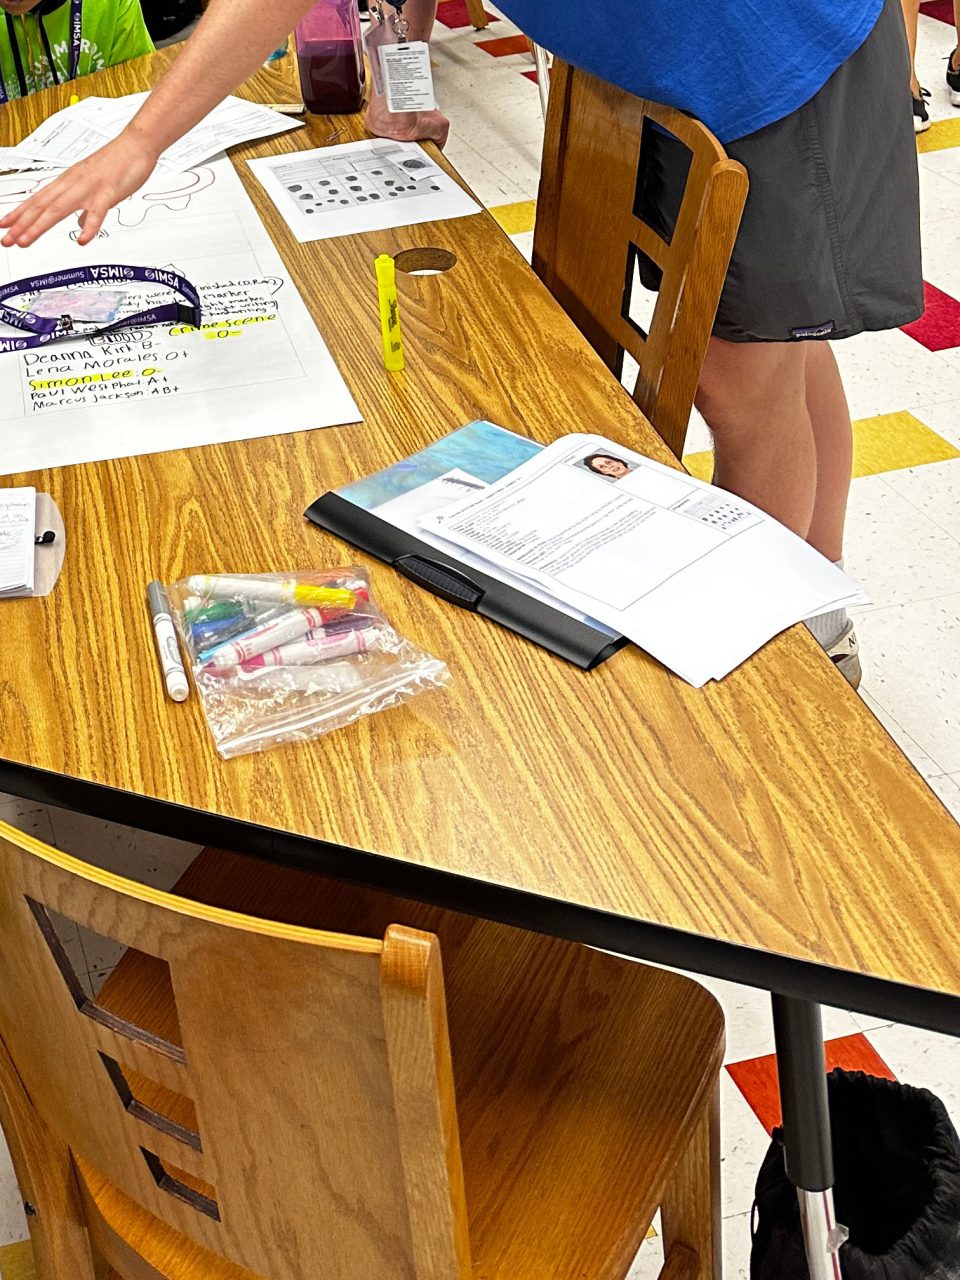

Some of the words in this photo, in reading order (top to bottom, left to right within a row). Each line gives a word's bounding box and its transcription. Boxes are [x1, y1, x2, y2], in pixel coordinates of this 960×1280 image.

[73, 23, 81, 46] IMSA
[90, 267, 124, 279] IMSA
[155, 270, 180, 289] IMSA
[23, 349, 94, 367] Deanna
[25, 363, 74, 378] Lena
[28, 375, 93, 392] Simon
